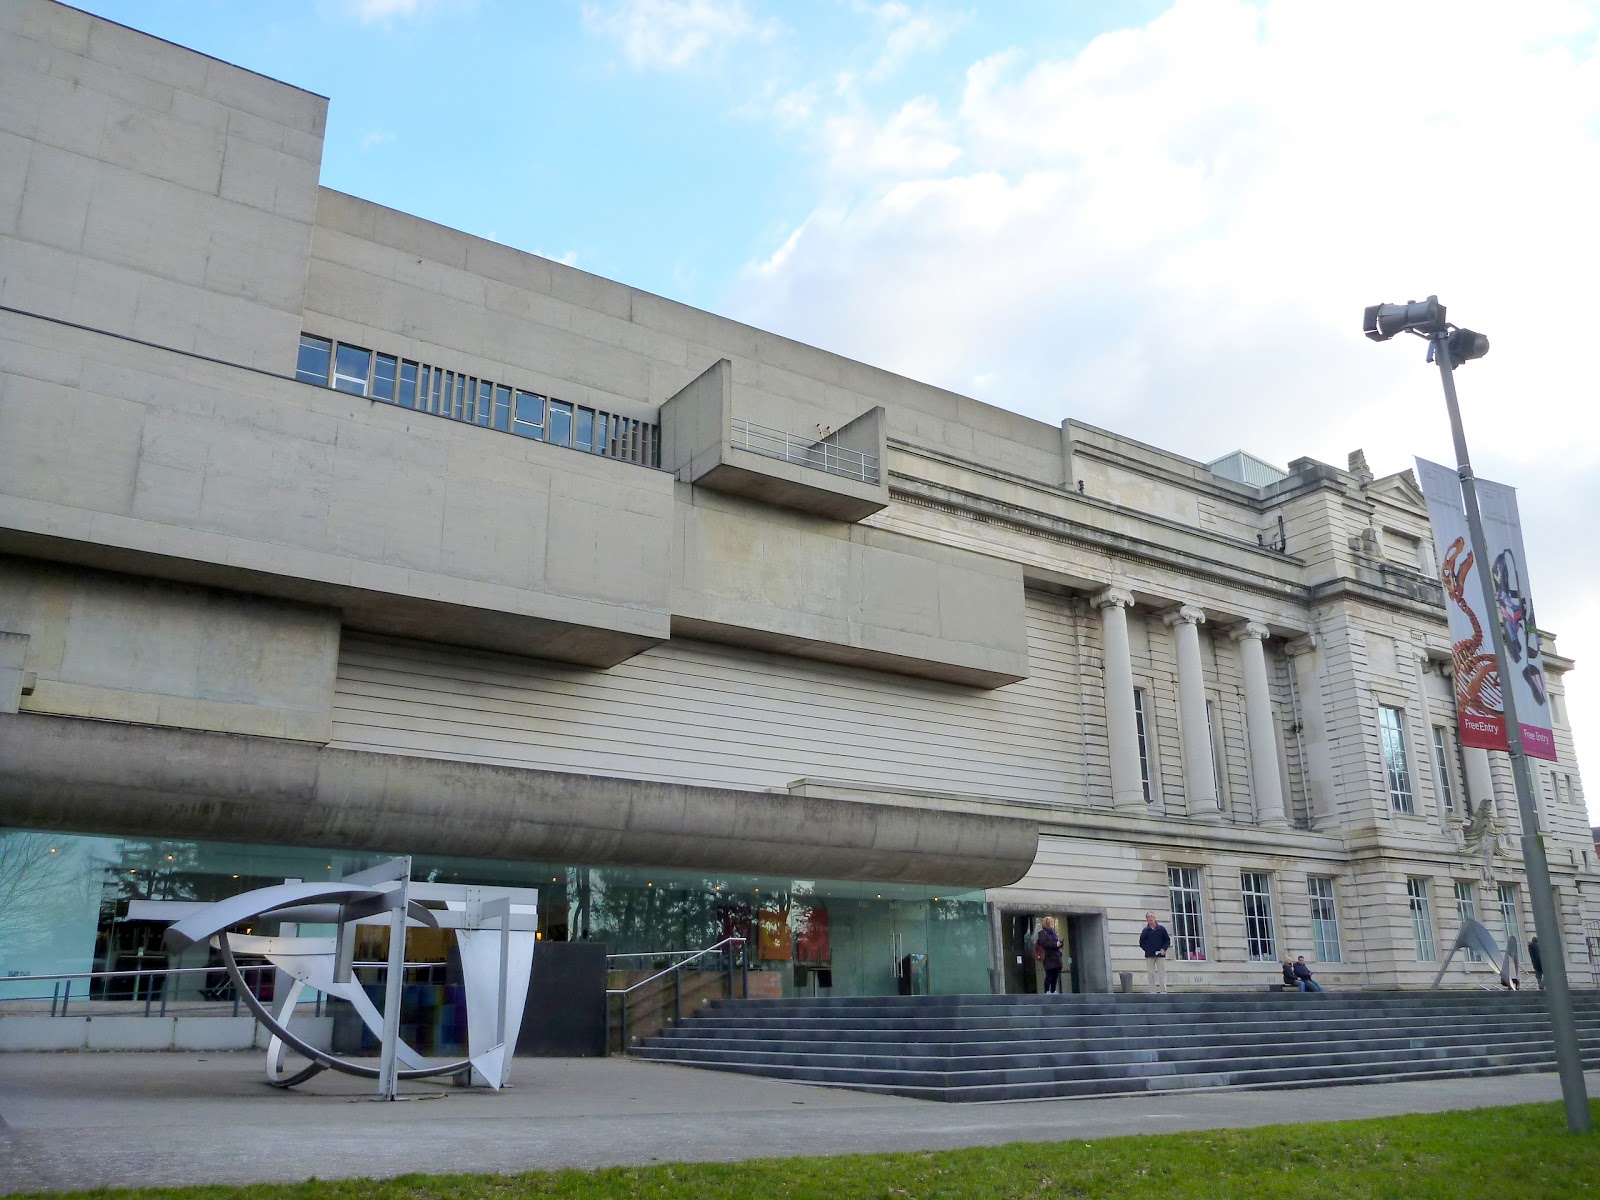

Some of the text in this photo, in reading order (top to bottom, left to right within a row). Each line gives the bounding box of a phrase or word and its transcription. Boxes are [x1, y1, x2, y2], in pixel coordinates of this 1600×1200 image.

[1464, 718, 1499, 735] Free Entry
[1523, 728, 1549, 745] Free Entry
